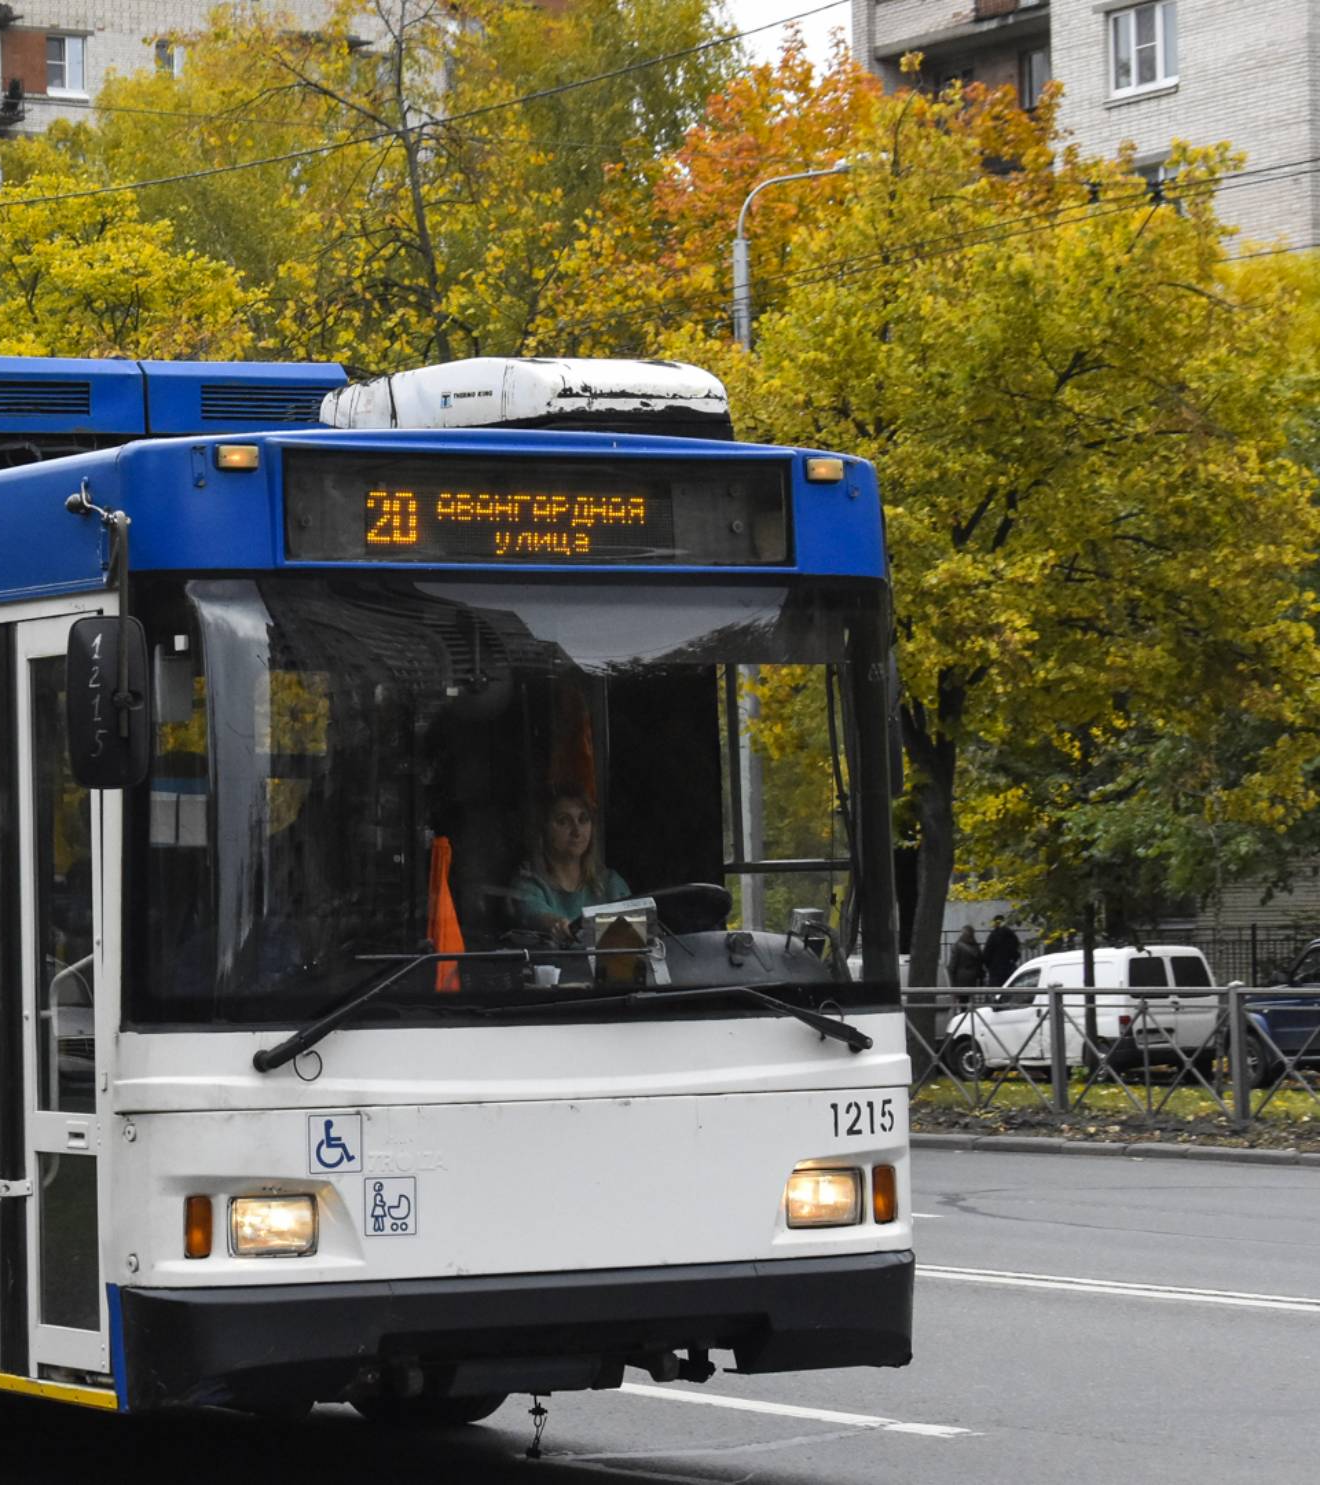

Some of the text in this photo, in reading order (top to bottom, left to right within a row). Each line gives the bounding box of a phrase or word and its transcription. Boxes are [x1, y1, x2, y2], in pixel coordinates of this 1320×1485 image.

[366, 490, 646, 544] 20 АВАНГАРДНАЯ
[494, 530, 591, 556] улица
[830, 1098, 895, 1138] 1215
